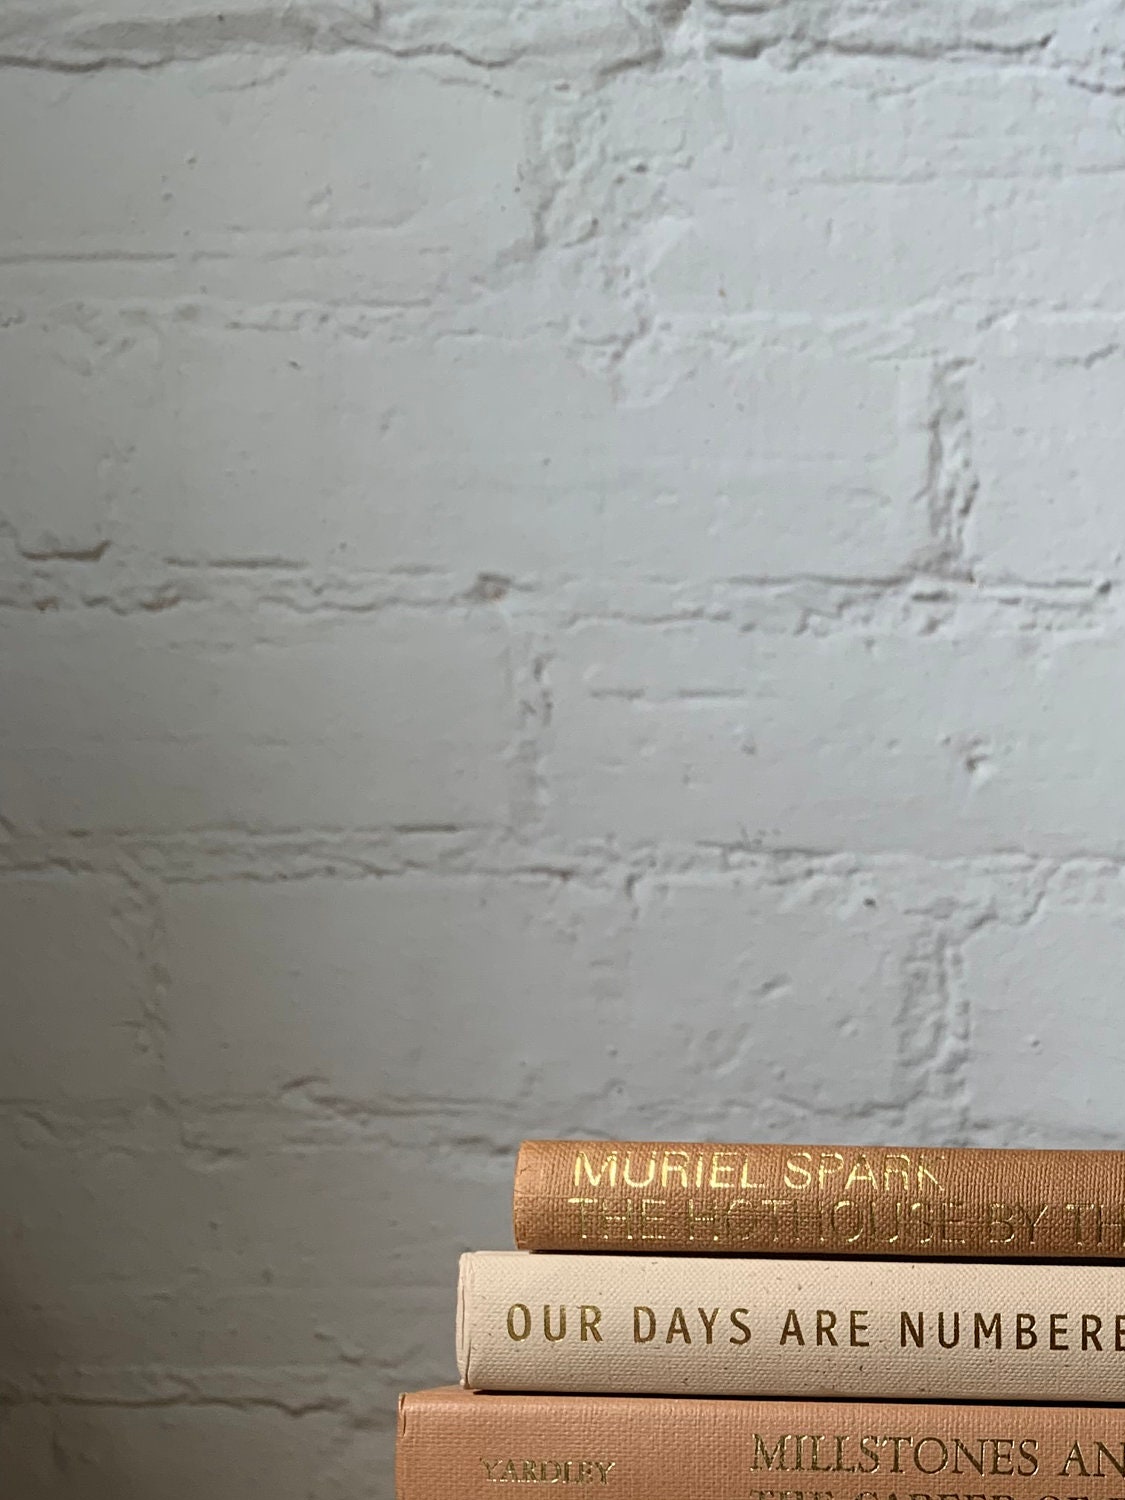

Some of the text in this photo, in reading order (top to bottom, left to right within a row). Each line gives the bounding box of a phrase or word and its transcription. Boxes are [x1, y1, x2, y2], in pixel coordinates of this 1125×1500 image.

[574, 1150, 946, 1192] MURIEL SPARK
[568, 1197, 666, 1240] THE
[988, 1203, 1049, 1246] BY
[506, 1302, 603, 1342] OUR
[632, 1305, 755, 1346] DAYS
[778, 1308, 871, 1348] ARE
[479, 1456, 616, 1485] YARDLEY
[750, 1432, 1040, 1477] MILLSTONES
